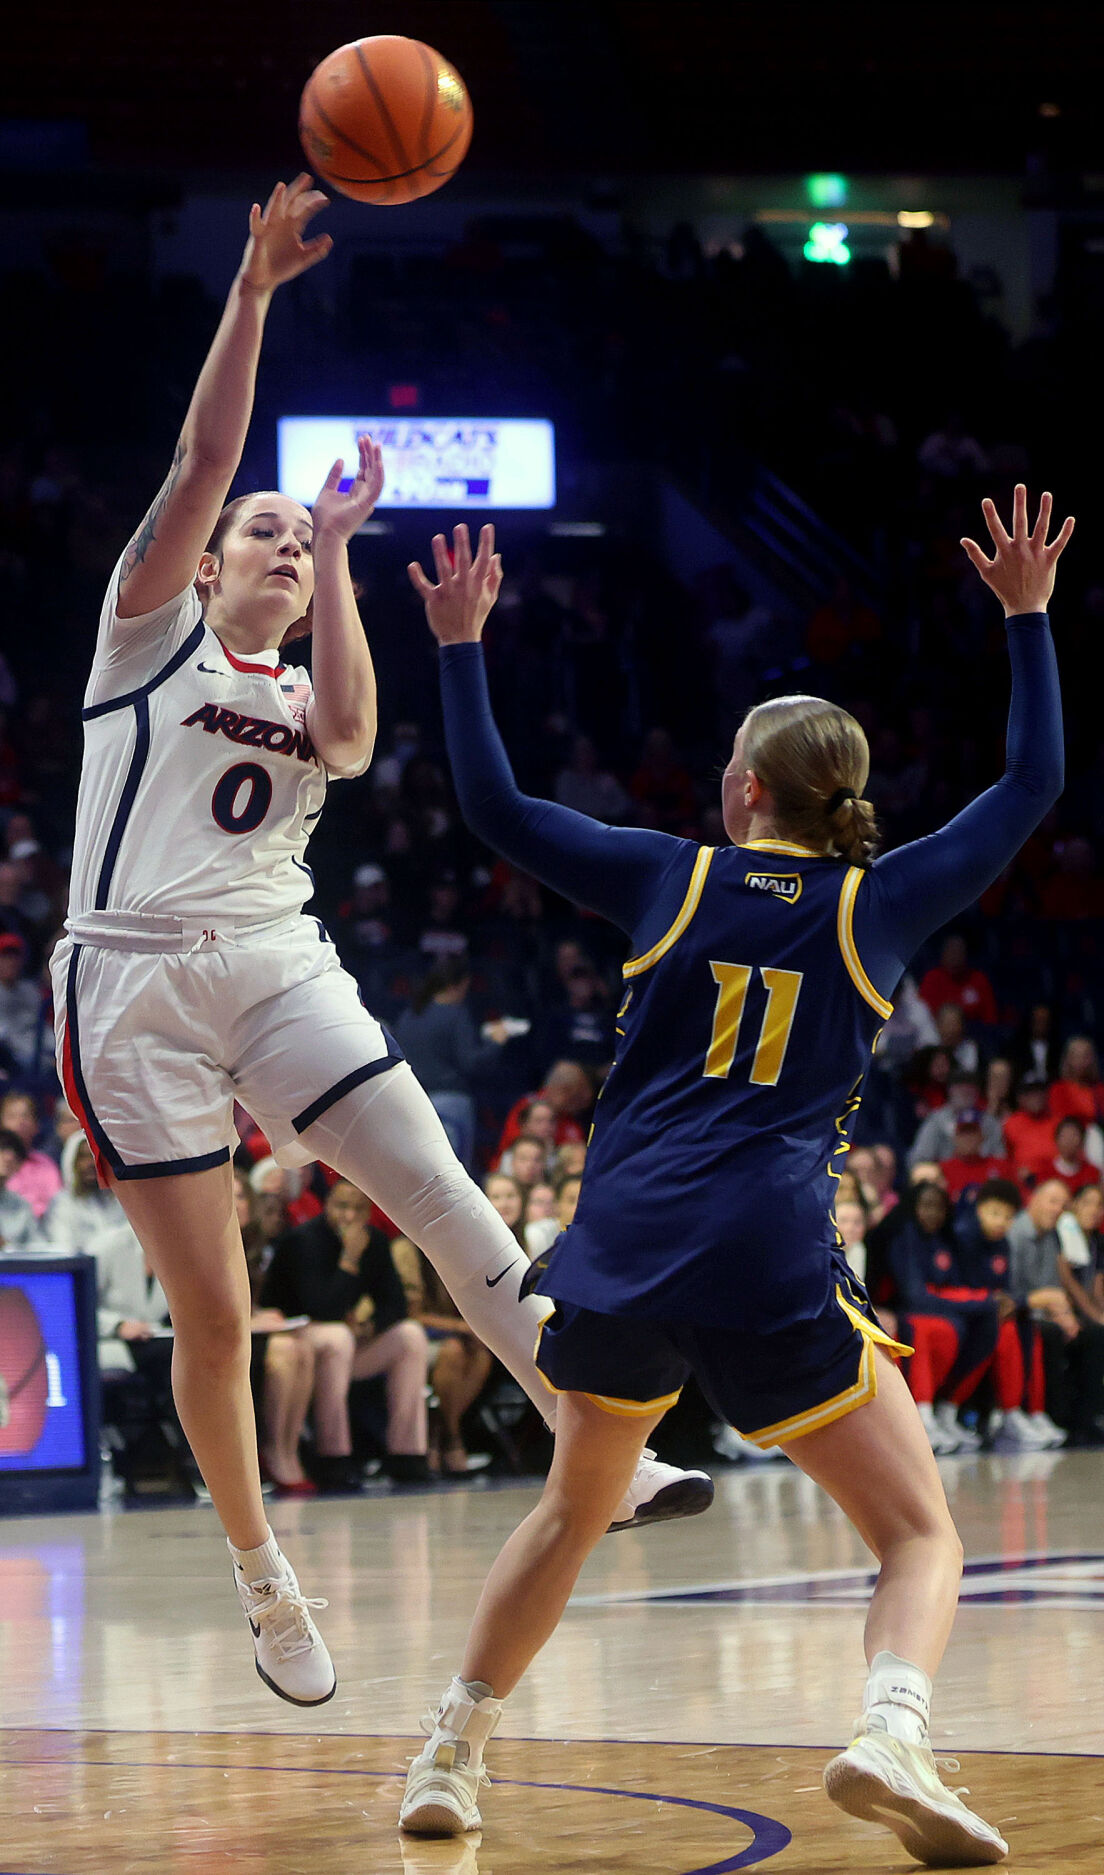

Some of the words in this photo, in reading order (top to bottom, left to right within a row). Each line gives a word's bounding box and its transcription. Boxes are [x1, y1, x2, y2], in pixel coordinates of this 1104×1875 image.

[180, 702, 319, 768] ARIZON
[211, 761, 273, 835] 0
[749, 876, 797, 895] NAU
[702, 959, 804, 1087] 11
